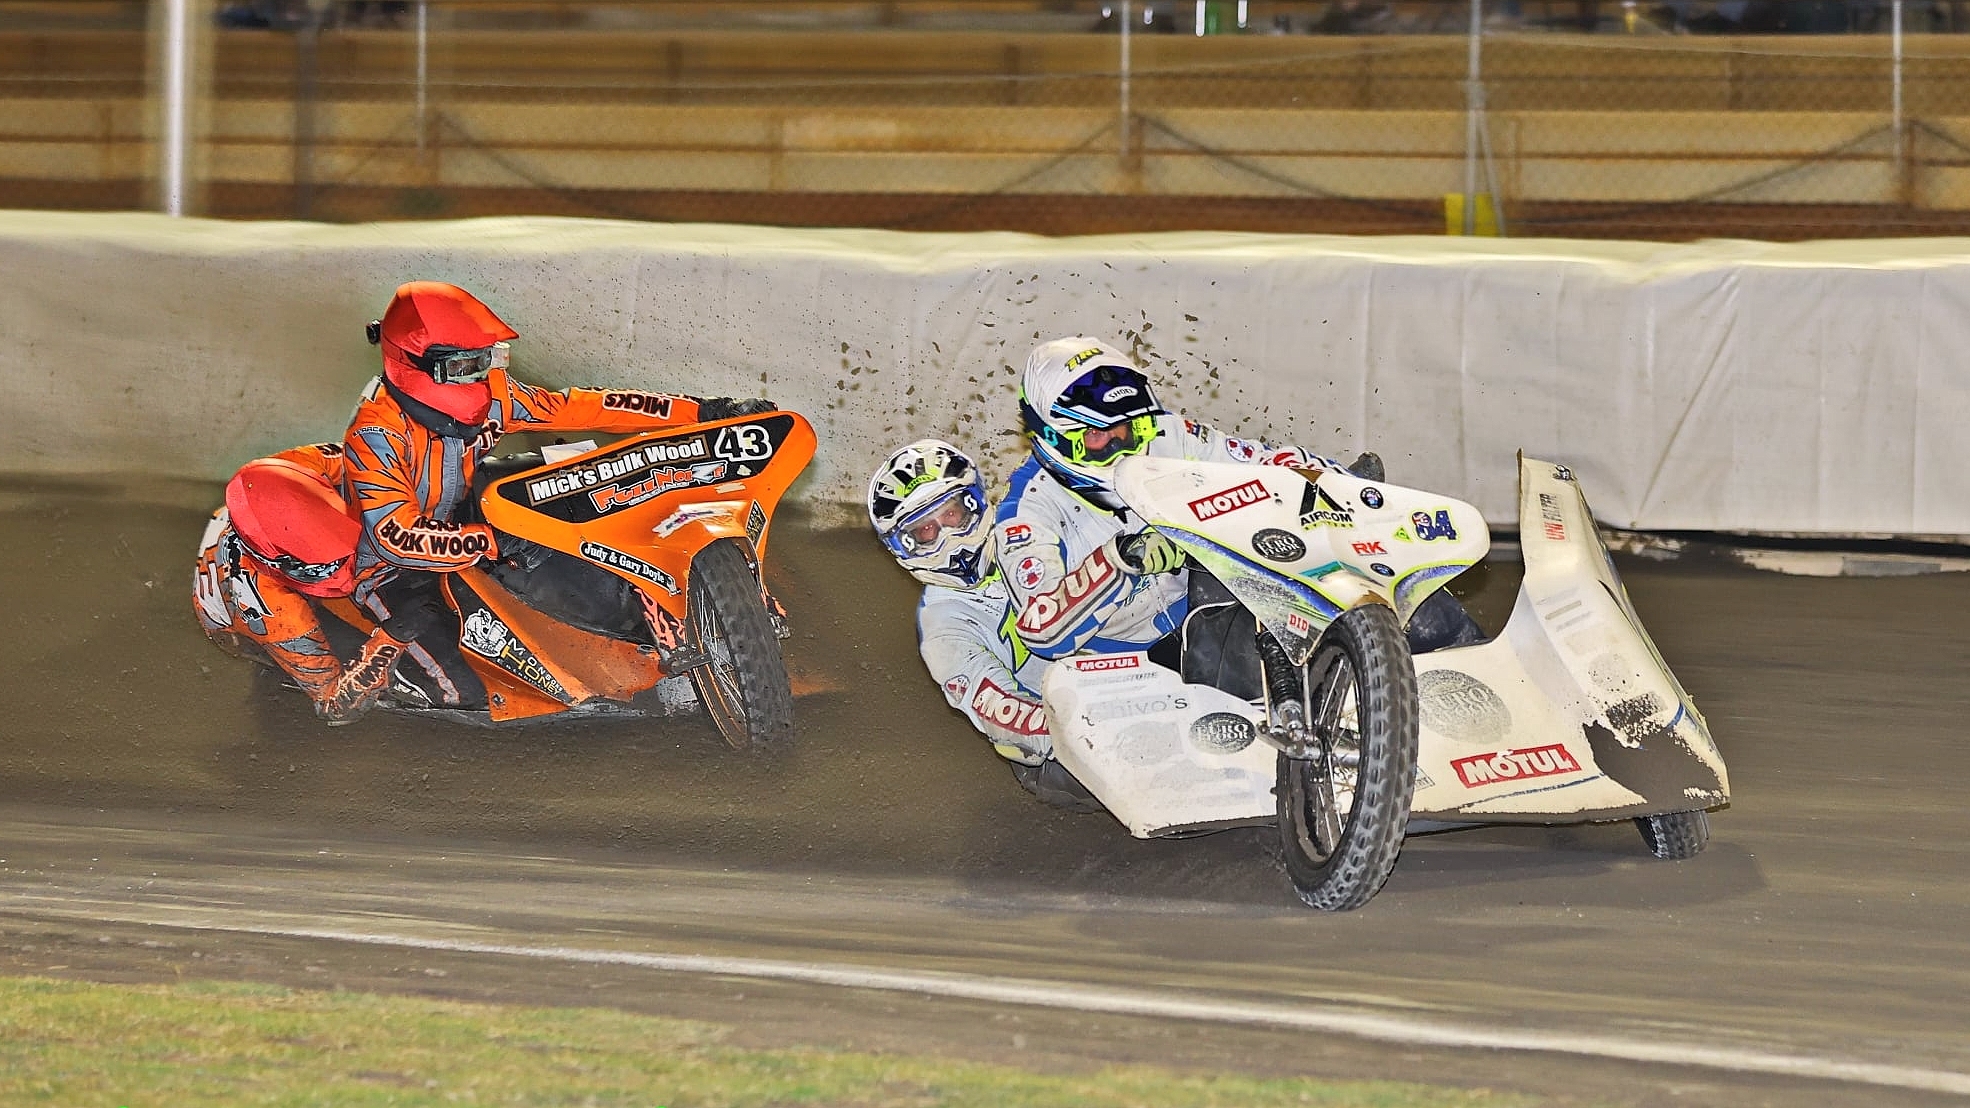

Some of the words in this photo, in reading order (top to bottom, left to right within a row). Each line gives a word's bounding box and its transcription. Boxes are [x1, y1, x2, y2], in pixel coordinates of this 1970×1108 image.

[603, 393, 669, 418] MICKS
[717, 426, 772, 462] 43
[532, 466, 597, 501] Mick's
[598, 451, 645, 482] Bulk
[647, 438, 706, 464] Wood
[1196, 484, 1269, 519] MOTUL
[1300, 510, 1353, 527] AIRCOM
[380, 519, 427, 554] BULK
[429, 533, 489, 556] WOOD
[1351, 541, 1388, 554] RK
[585, 543, 608, 562] Judy
[608, 552, 618, 563] &
[619, 554, 641, 575] Gary
[642, 561, 666, 584] Doyle
[1288, 613, 1309, 632] DID
[500, 645, 560, 695] HONEY
[1079, 657, 1137, 671] MOTUL
[1461, 749, 1575, 785] MOTUL
